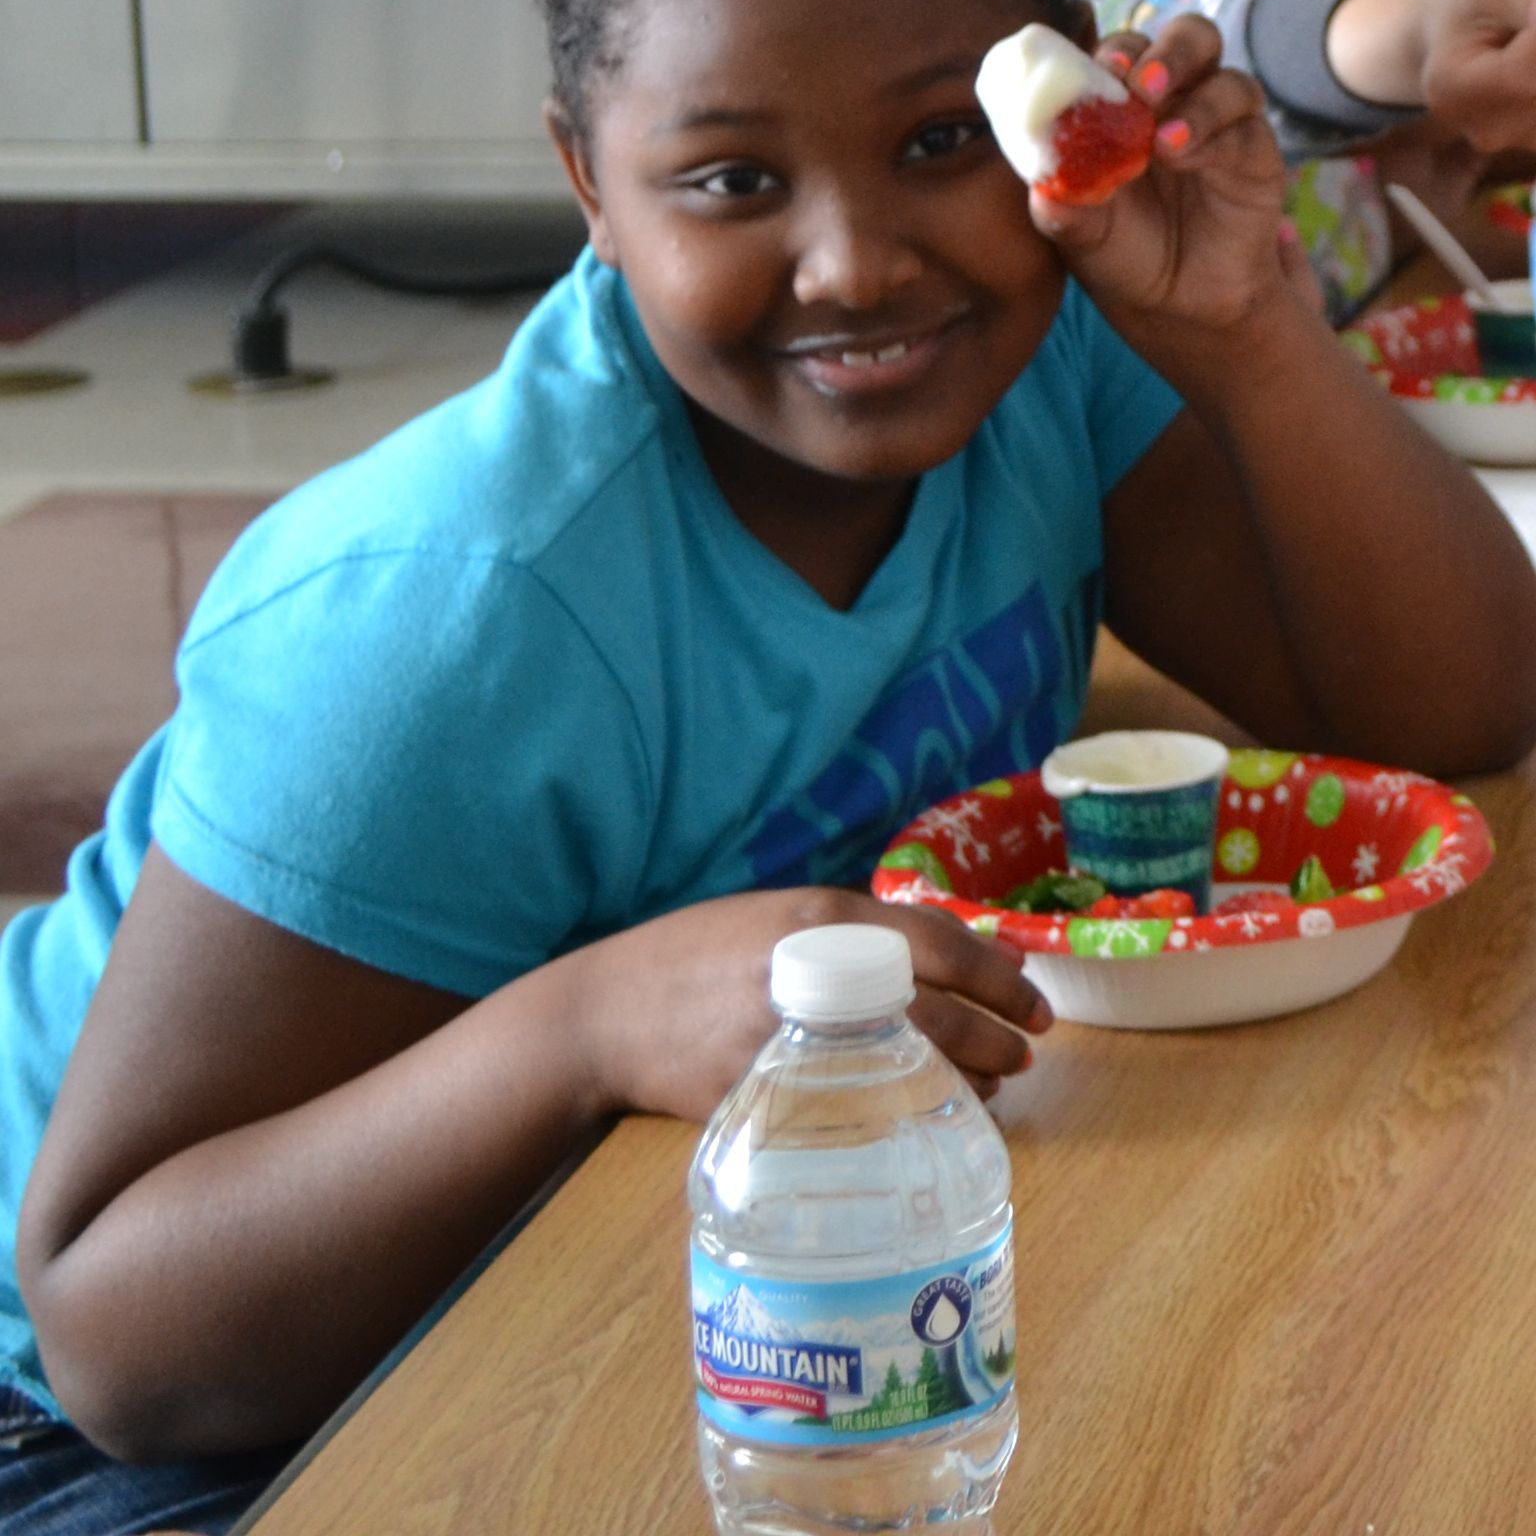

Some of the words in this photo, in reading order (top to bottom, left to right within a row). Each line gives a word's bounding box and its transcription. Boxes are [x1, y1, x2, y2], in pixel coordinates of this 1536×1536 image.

[913, 1280, 942, 1317] GREAT
[945, 1278, 971, 1302] TASTE
[712, 1327, 849, 1386] MOUNTAIN
[785, 1391, 818, 1409] WATER
